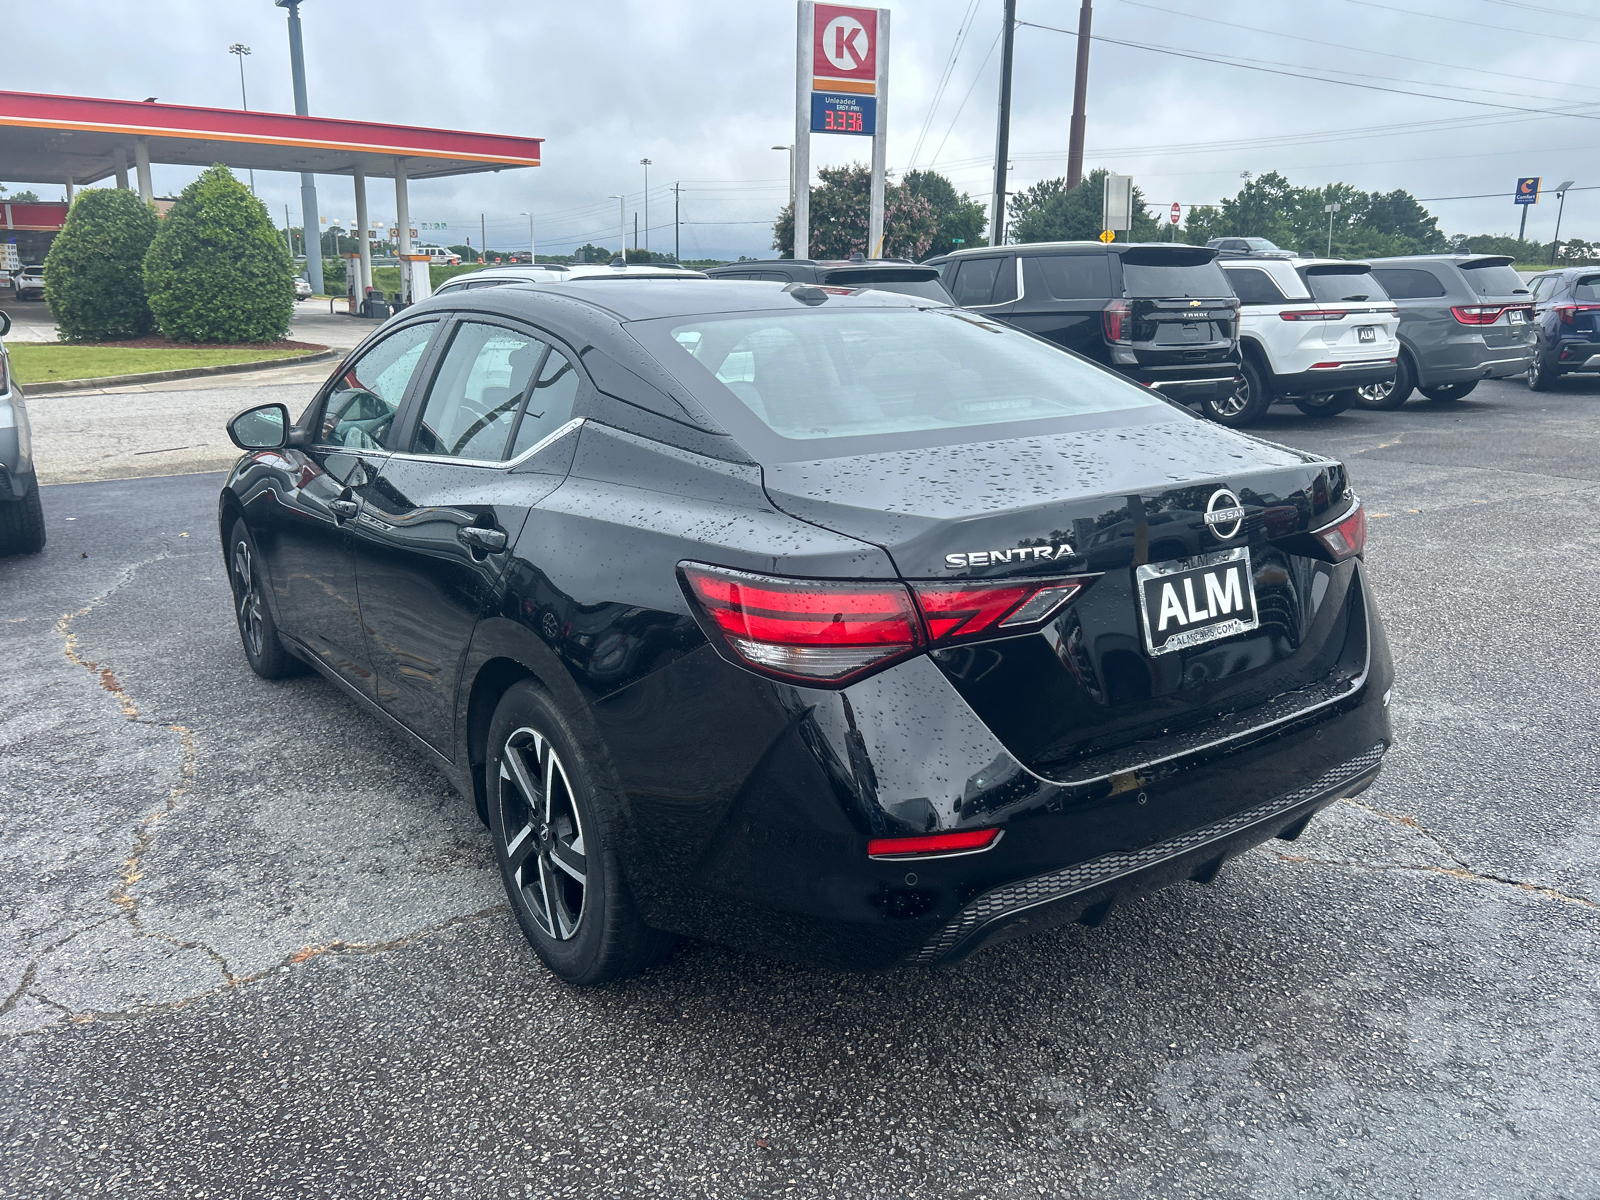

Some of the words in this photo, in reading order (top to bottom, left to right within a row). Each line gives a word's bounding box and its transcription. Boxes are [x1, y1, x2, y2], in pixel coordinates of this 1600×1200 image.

[835, 26, 862, 67] K
[825, 97, 856, 105] Unleaded
[1360, 330, 1375, 340] ALM
[1206, 508, 1245, 523] NISSAN
[945, 544, 1076, 569] SENTRA
[1183, 554, 1209, 570] ALM
[1158, 567, 1244, 632] ALM
[1176, 622, 1235, 646] ALMCARS.COM
